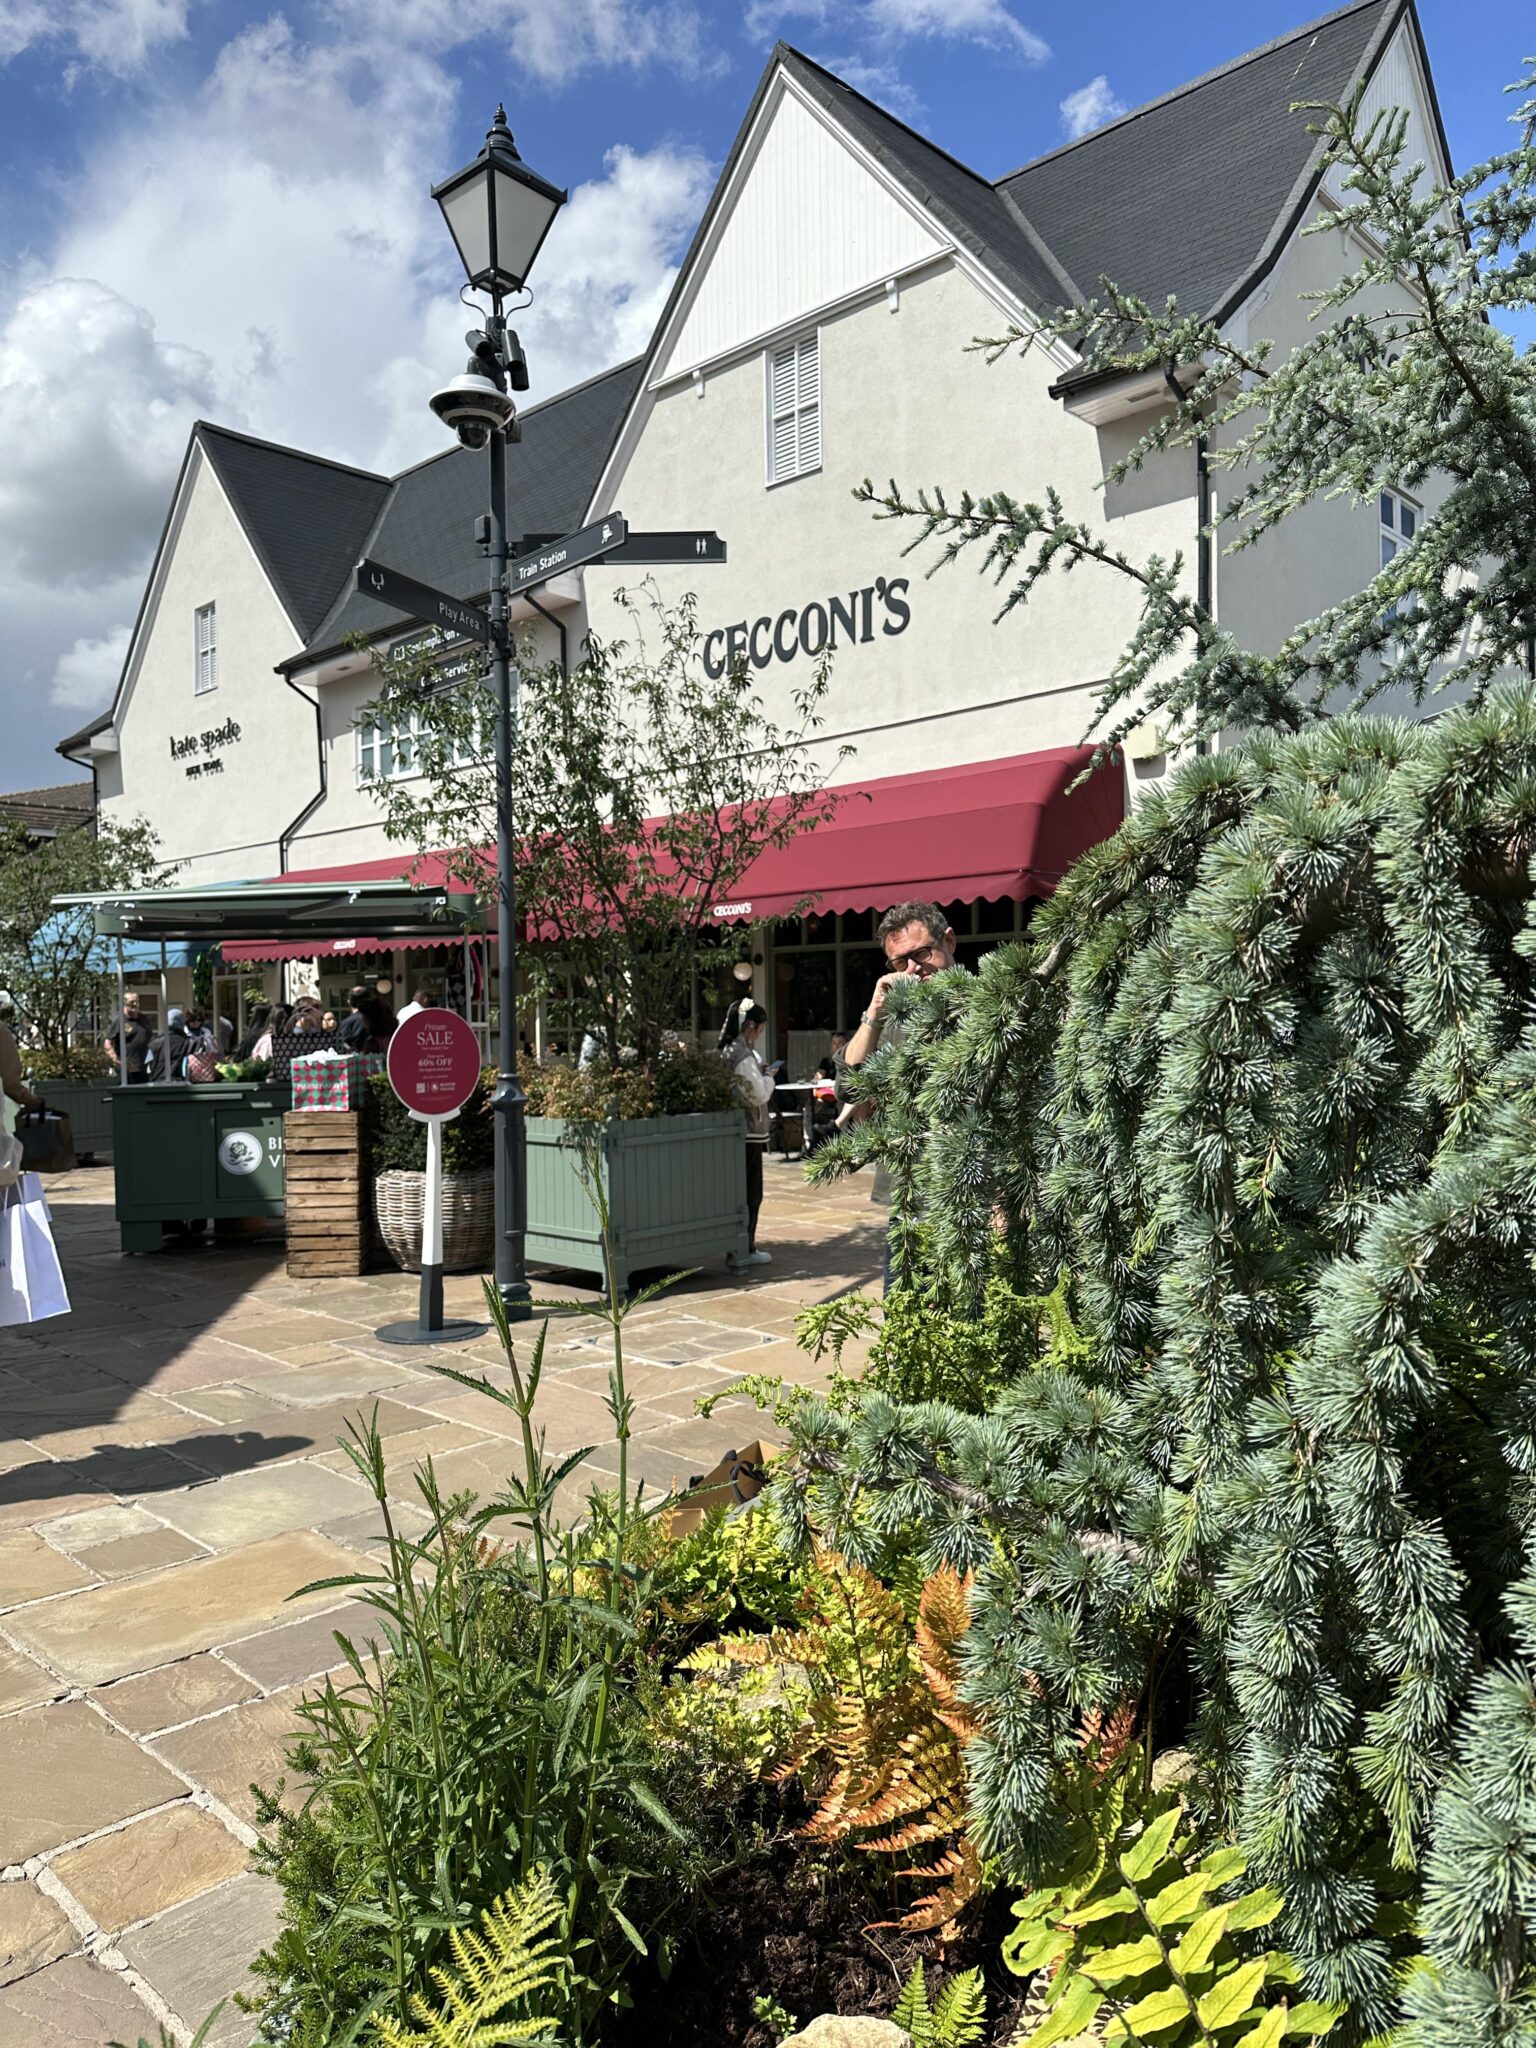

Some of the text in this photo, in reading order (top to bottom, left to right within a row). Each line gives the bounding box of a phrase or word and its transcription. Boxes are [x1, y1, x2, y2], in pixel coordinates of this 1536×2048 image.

[519, 550, 567, 580] Train Station
[439, 601, 480, 630] Play Area
[703, 576, 911, 680] CECCONI'S
[170, 717, 241, 757] kate spade
[417, 1031, 454, 1046] SALE
[418, 1058, 453, 1067] 60% OFF
